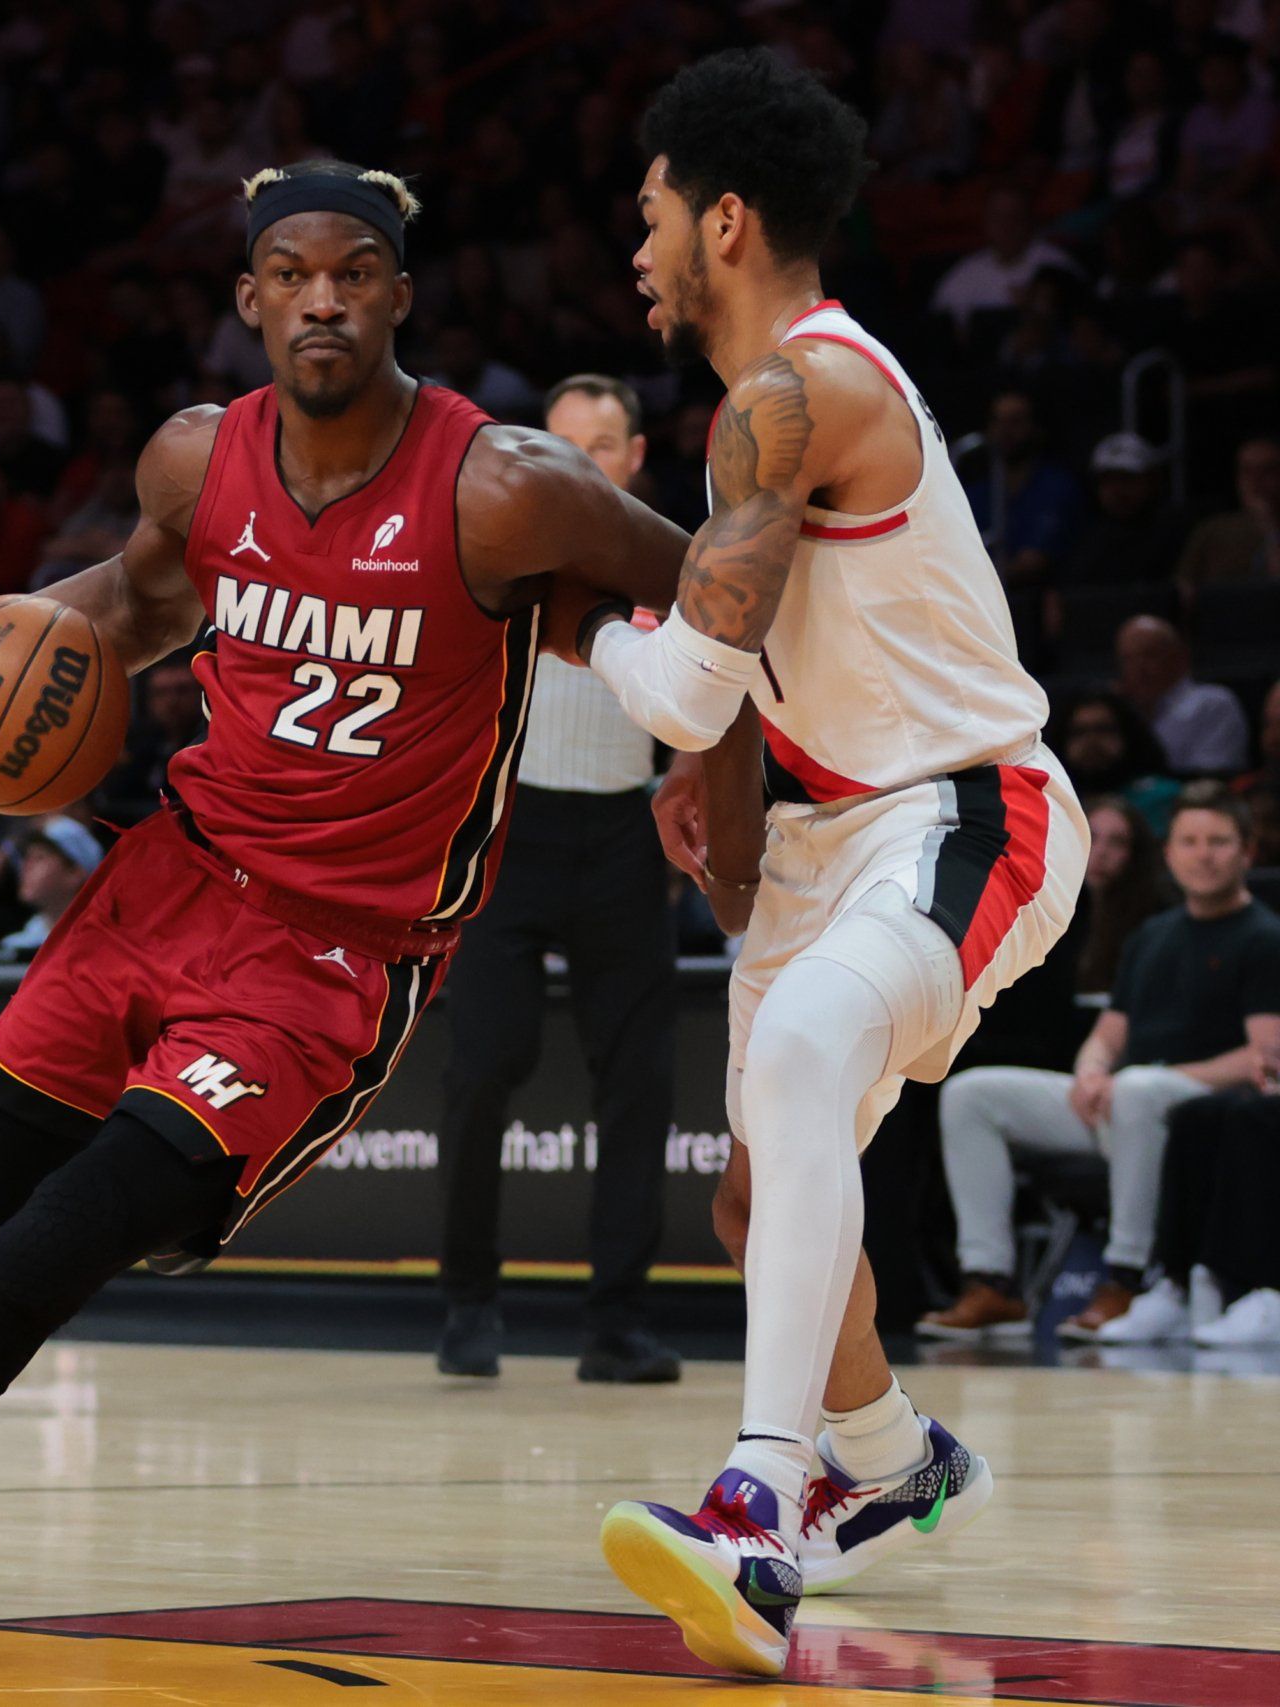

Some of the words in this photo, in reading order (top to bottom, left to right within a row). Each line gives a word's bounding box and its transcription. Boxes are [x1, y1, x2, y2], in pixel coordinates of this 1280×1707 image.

[351, 558, 419, 572] Robinhood
[215, 575, 424, 667] MIAMI
[270, 660, 403, 758] 22
